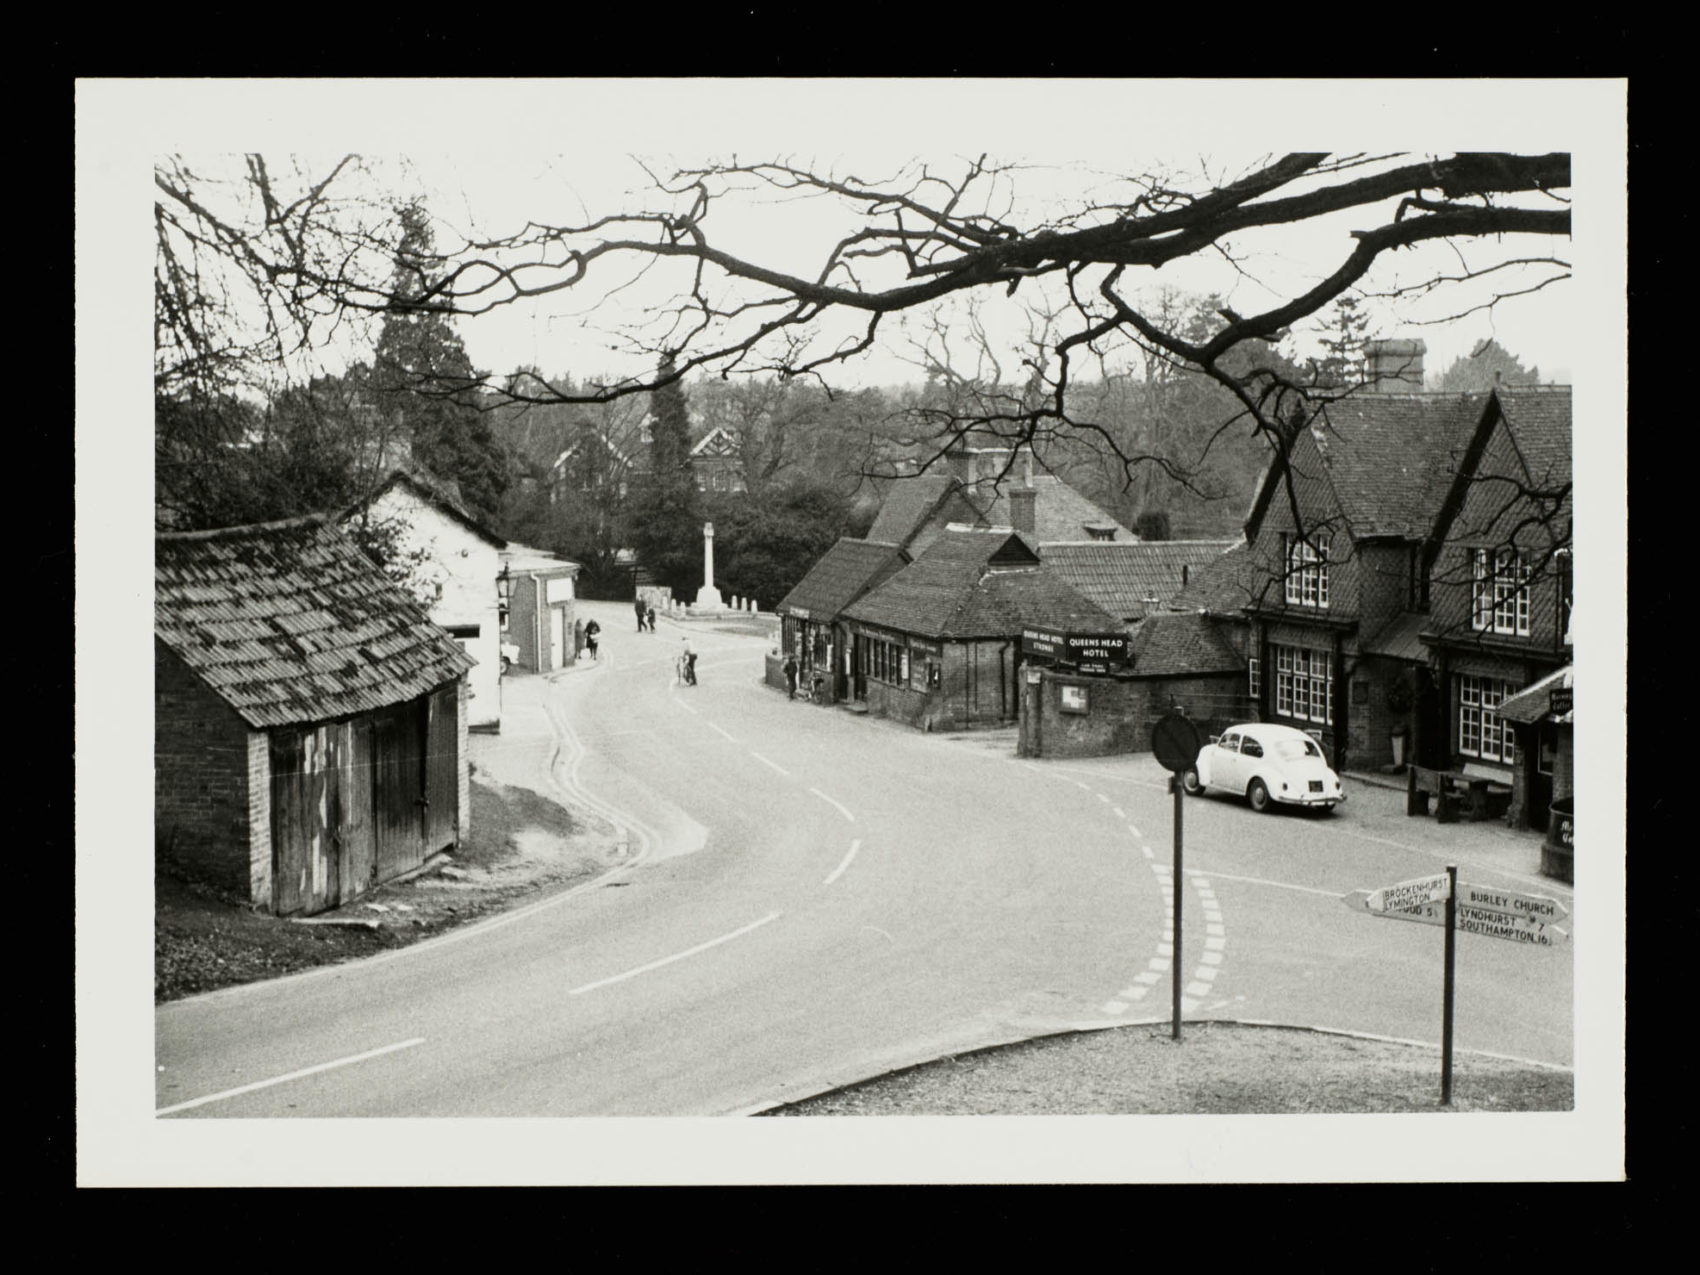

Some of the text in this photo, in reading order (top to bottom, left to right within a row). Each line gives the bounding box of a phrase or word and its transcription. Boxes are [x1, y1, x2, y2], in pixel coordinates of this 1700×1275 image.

[1069, 638, 1123, 648] QUEENS HEAD
[1083, 649, 1109, 658] HOTEL
[1384, 878, 1448, 900] BROCKENHURST
[1383, 893, 1431, 912] LYMINGTON
[1470, 891, 1554, 916] BURLEY CHURCH
[1460, 908, 1515, 927] LYNDHURST
